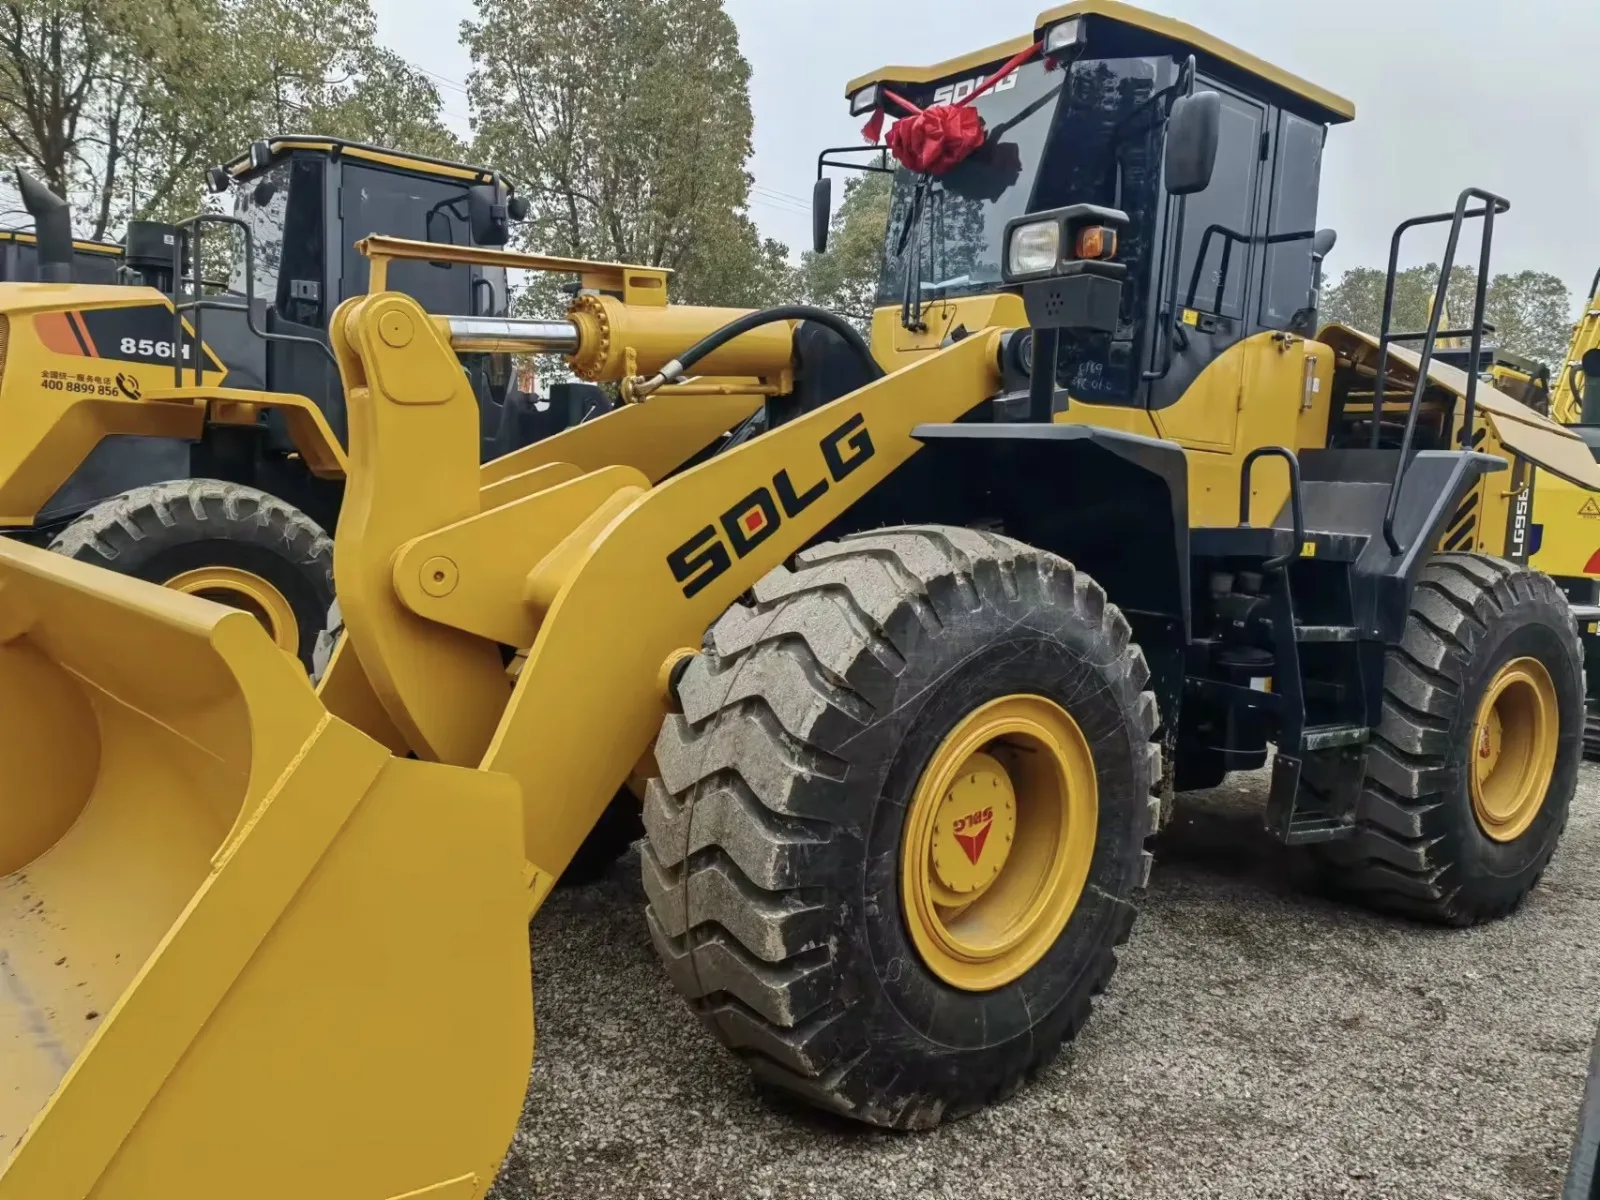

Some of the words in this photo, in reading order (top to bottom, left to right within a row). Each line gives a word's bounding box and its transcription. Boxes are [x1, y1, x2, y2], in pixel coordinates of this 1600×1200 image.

[120, 337, 191, 360] 856H
[41, 369, 112, 386] 全国统一服务电话
[41, 379, 64, 391] 400
[66, 381, 96, 394] 8899
[97, 385, 119, 397] 856
[666, 412, 876, 599] SDLG
[1511, 481, 1530, 557] LG956
